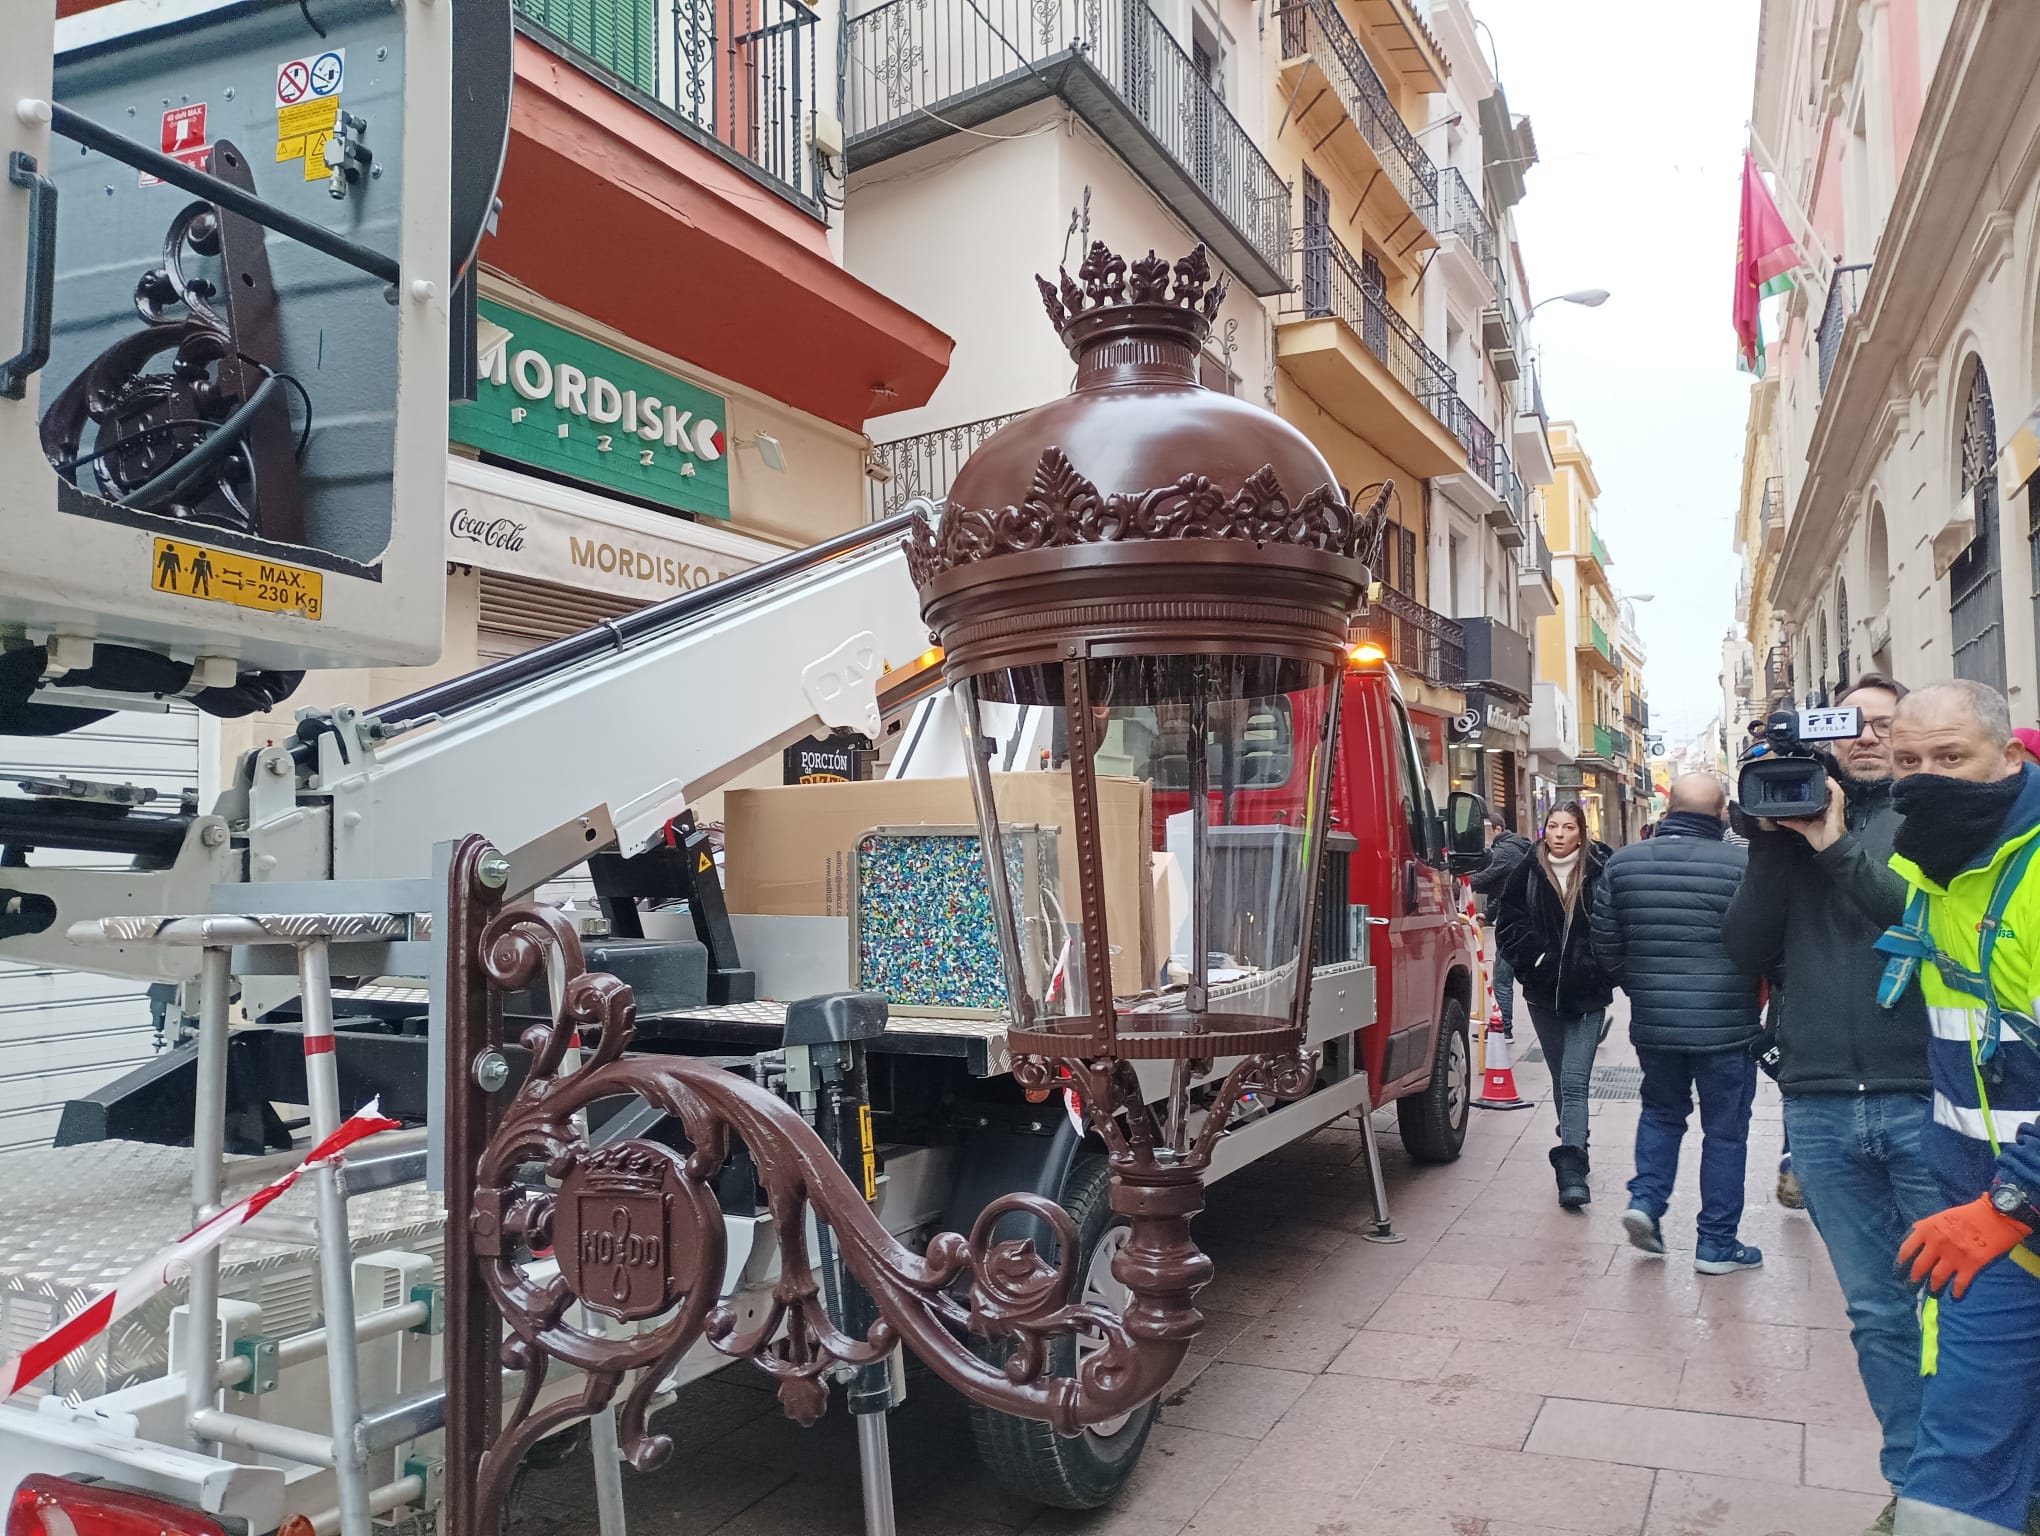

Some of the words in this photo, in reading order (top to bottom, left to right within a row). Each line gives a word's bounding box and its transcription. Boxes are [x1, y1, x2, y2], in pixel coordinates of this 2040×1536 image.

[511, 407, 696, 477] PIZZA
[450, 508, 527, 552] Coca-Cola
[569, 536, 710, 590] MORDISKO
[260, 565, 305, 588] MAX.
[257, 584, 289, 604] 230
[295, 591, 318, 613] Kg
[1808, 725, 1847, 733] SEVILLA
[801, 749, 848, 771] PORCIÓN
[804, 766, 812, 774] de
